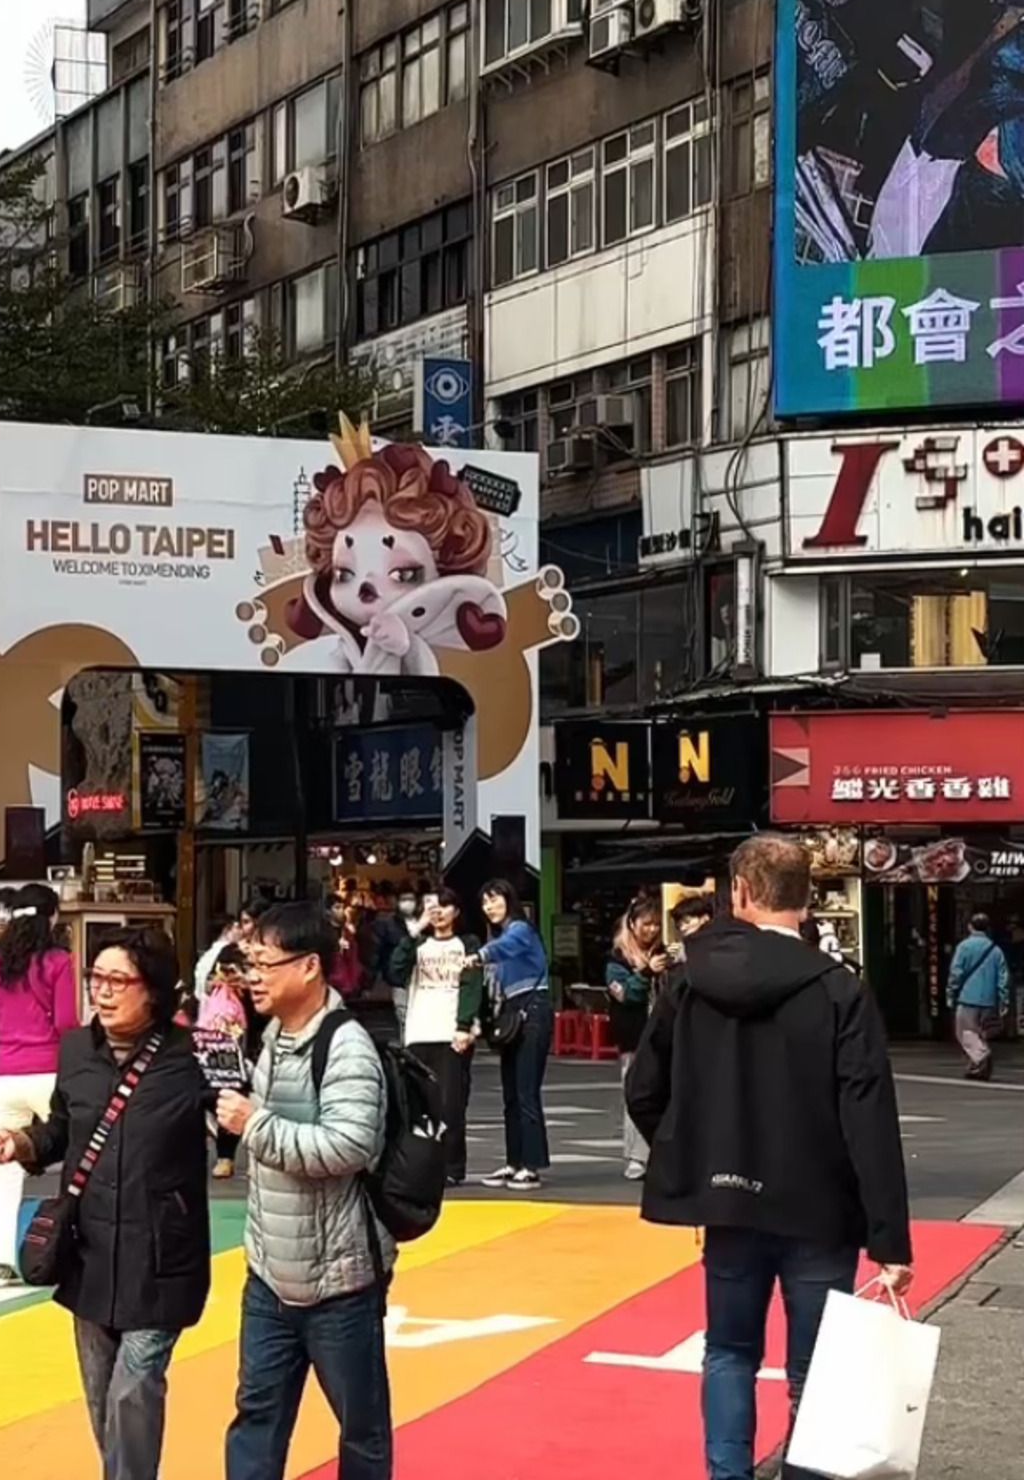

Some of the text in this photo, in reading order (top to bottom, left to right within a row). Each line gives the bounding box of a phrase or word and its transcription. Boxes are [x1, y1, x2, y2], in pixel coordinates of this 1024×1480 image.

[87, 477, 170, 503] POP MART
[26, 519, 235, 559] HELLO TAIPEI
[53, 559, 211, 580] WELCOME TO XIMENDING
[590, 737, 629, 792] N
[679, 729, 710, 784] N
[864, 766, 898, 776] FRIED
[900, 766, 953, 776] CHICKEN
[452, 729, 465, 832] OP MART
[989, 866, 1020, 877] FRIED
